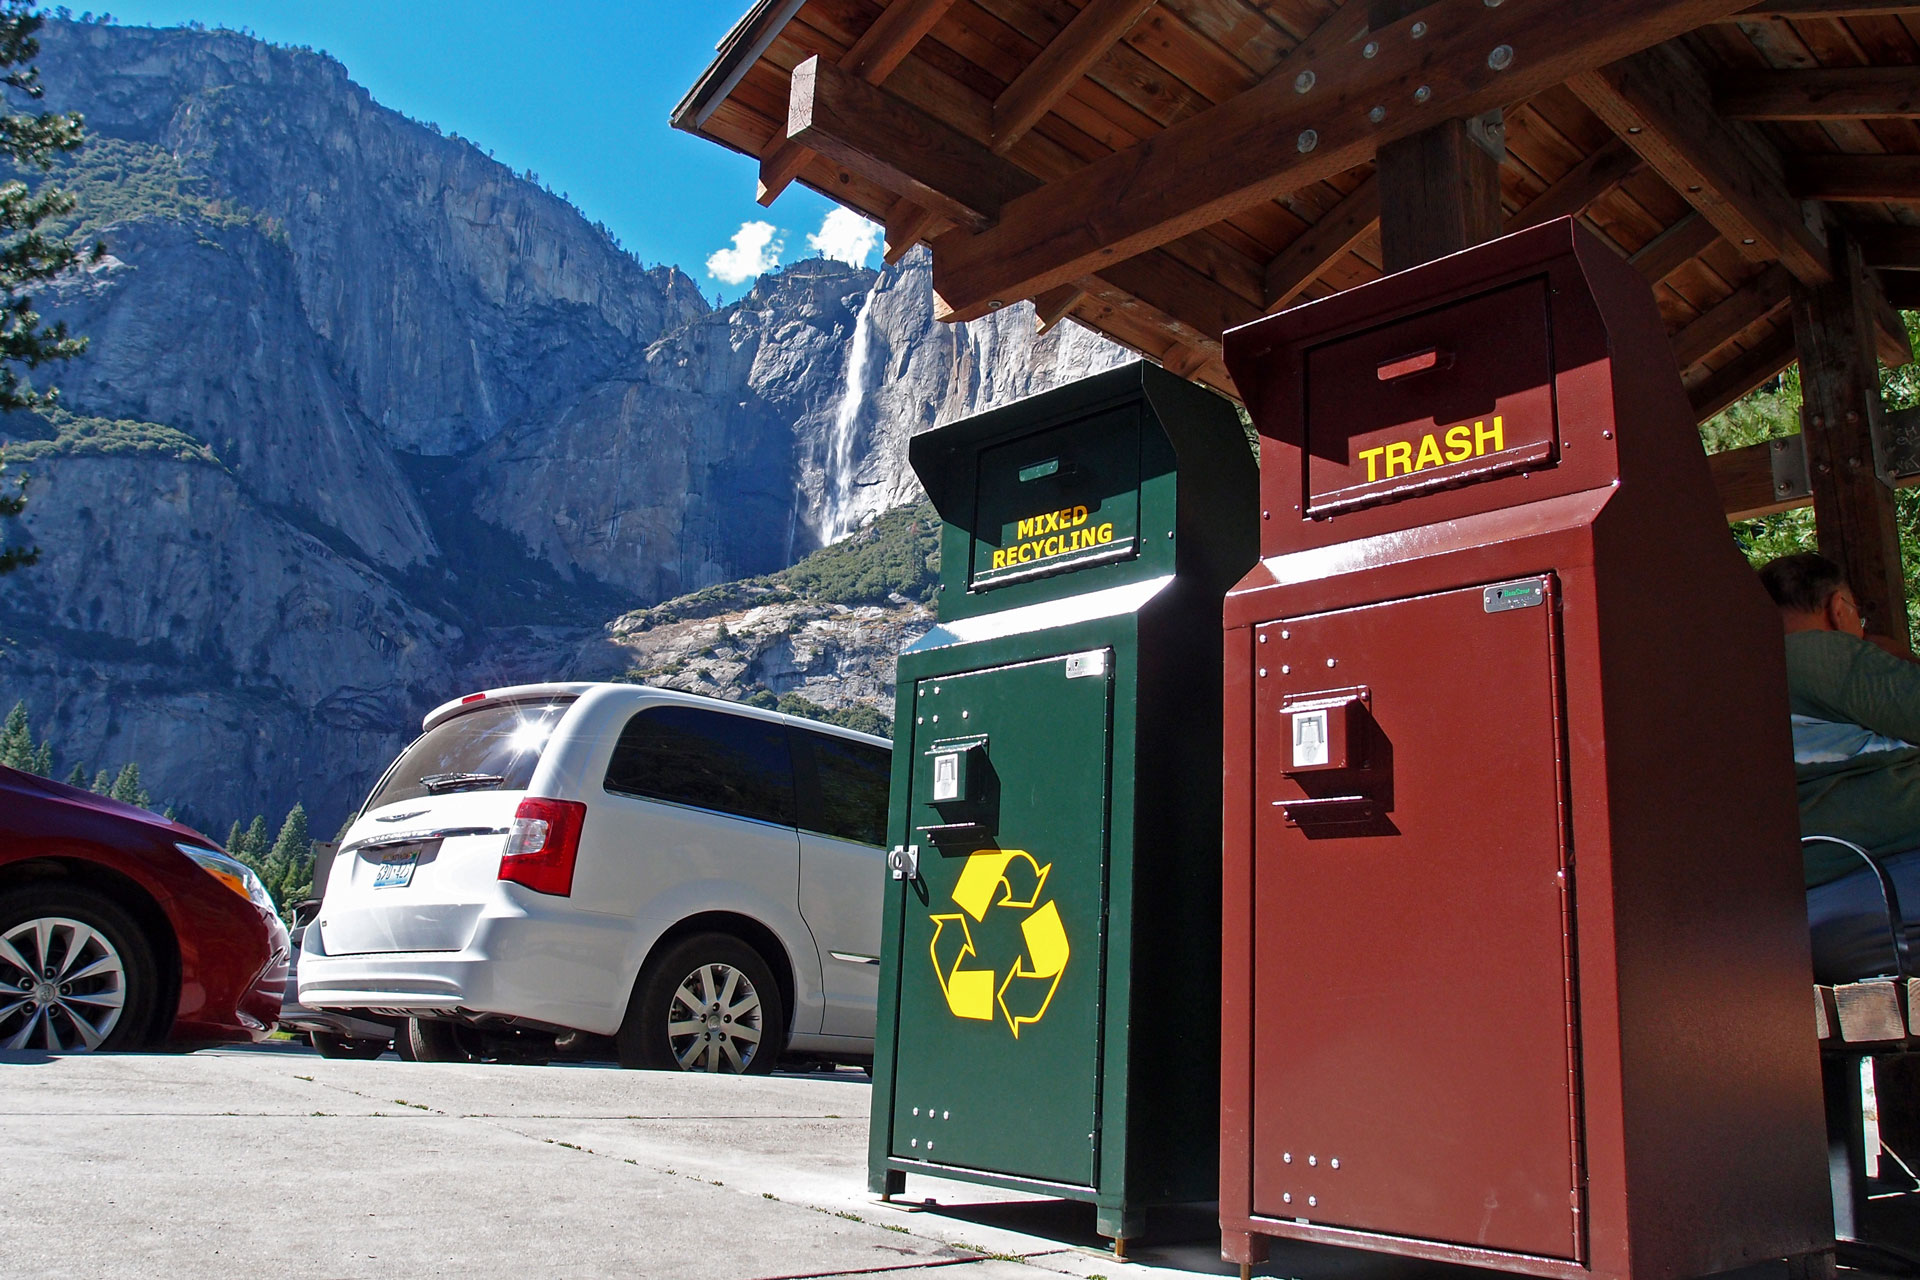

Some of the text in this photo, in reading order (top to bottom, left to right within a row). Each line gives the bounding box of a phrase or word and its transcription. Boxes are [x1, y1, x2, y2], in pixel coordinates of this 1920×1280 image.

[1358, 415, 1504, 482] TRASH
[992, 522, 1113, 569] RECYCLING
[1017, 505, 1089, 540] MIXED
